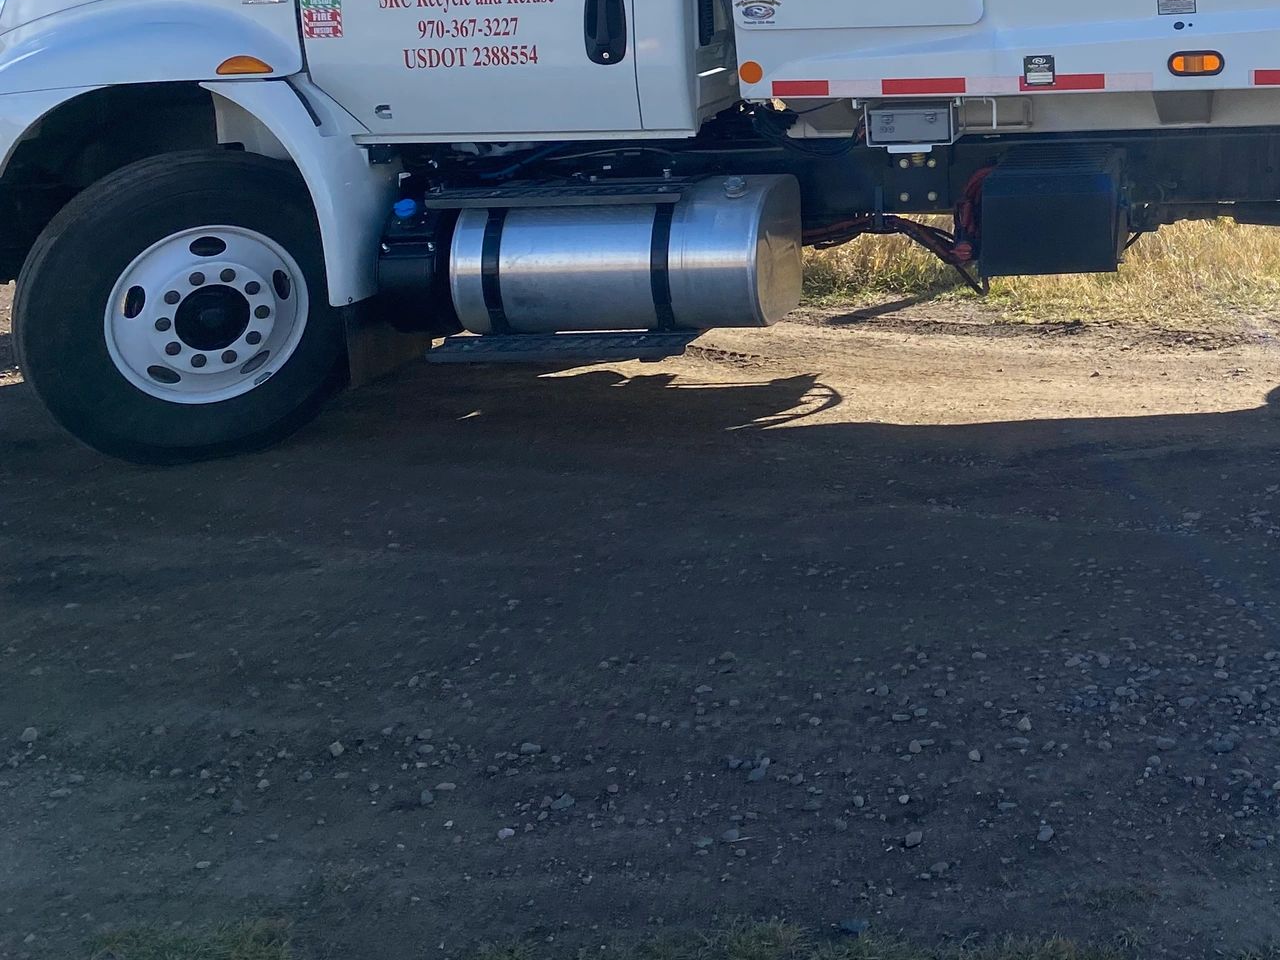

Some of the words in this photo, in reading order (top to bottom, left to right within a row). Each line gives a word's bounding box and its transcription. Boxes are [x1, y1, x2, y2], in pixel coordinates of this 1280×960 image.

[312, 12, 332, 21] FIRE
[418, 17, 519, 39] 970-367-3227
[403, 47, 468, 70] USDOT
[472, 44, 538, 67] 2388554
